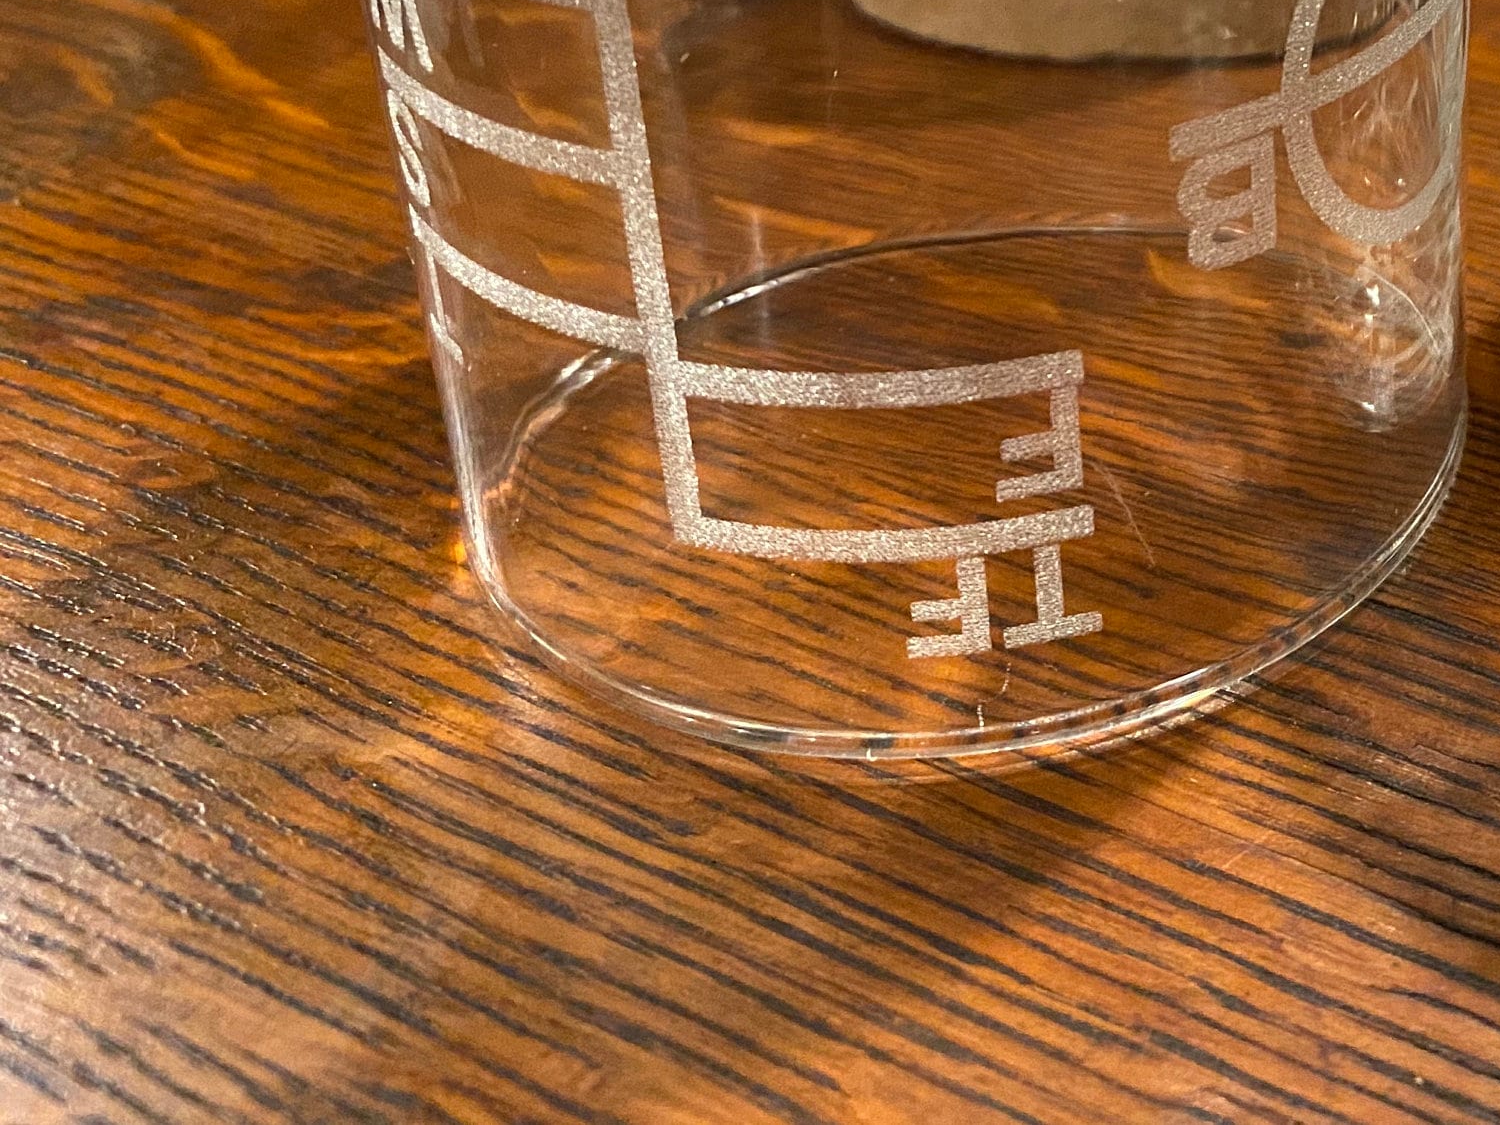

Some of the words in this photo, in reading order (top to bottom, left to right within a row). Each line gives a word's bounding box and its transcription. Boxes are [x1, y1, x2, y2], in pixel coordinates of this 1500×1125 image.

[1176, 127, 1278, 272] B
[995, 382, 1084, 504] F
[906, 542, 1104, 660] TF
